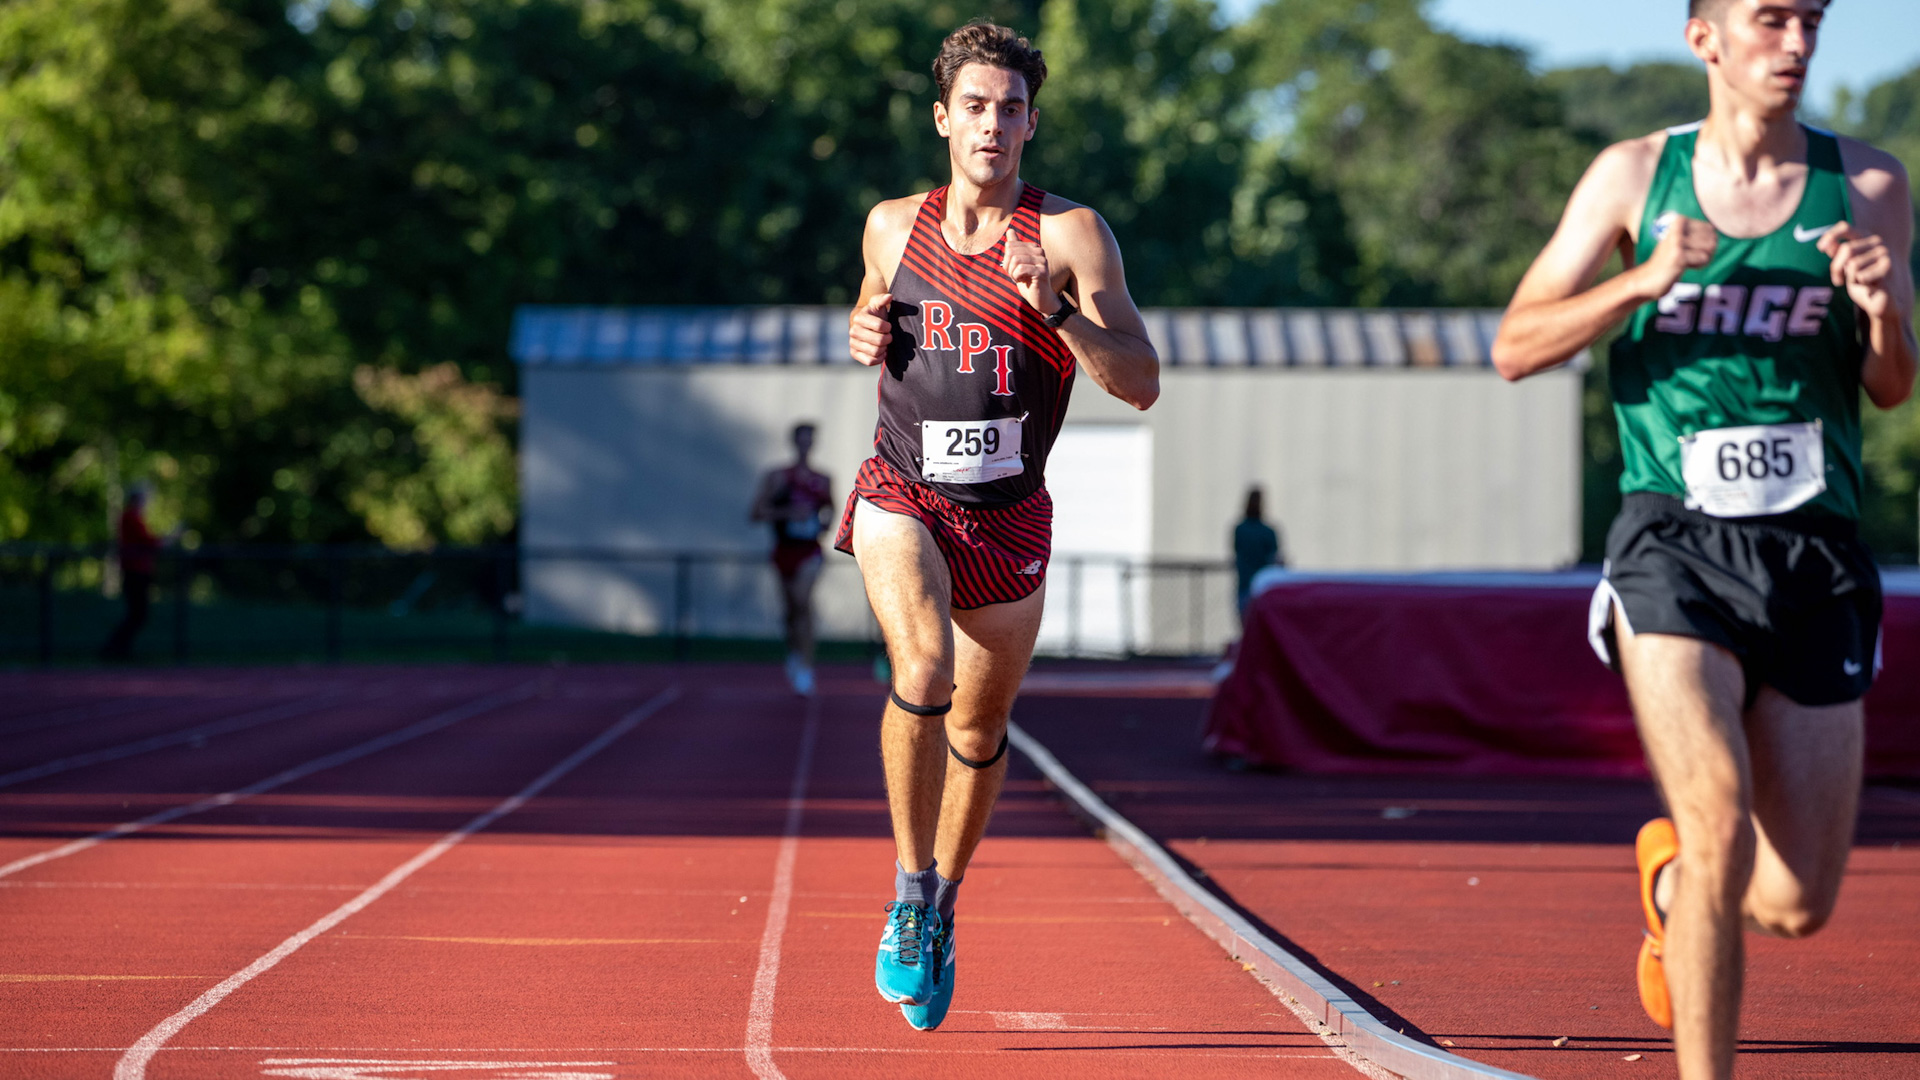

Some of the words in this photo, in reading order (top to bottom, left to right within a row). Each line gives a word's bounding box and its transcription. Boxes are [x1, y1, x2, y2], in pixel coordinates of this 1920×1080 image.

[1655, 282, 1834, 342] SAGE
[919, 300, 1015, 396] RPI
[945, 427, 1000, 457] 259
[1717, 438, 1794, 482] 685
